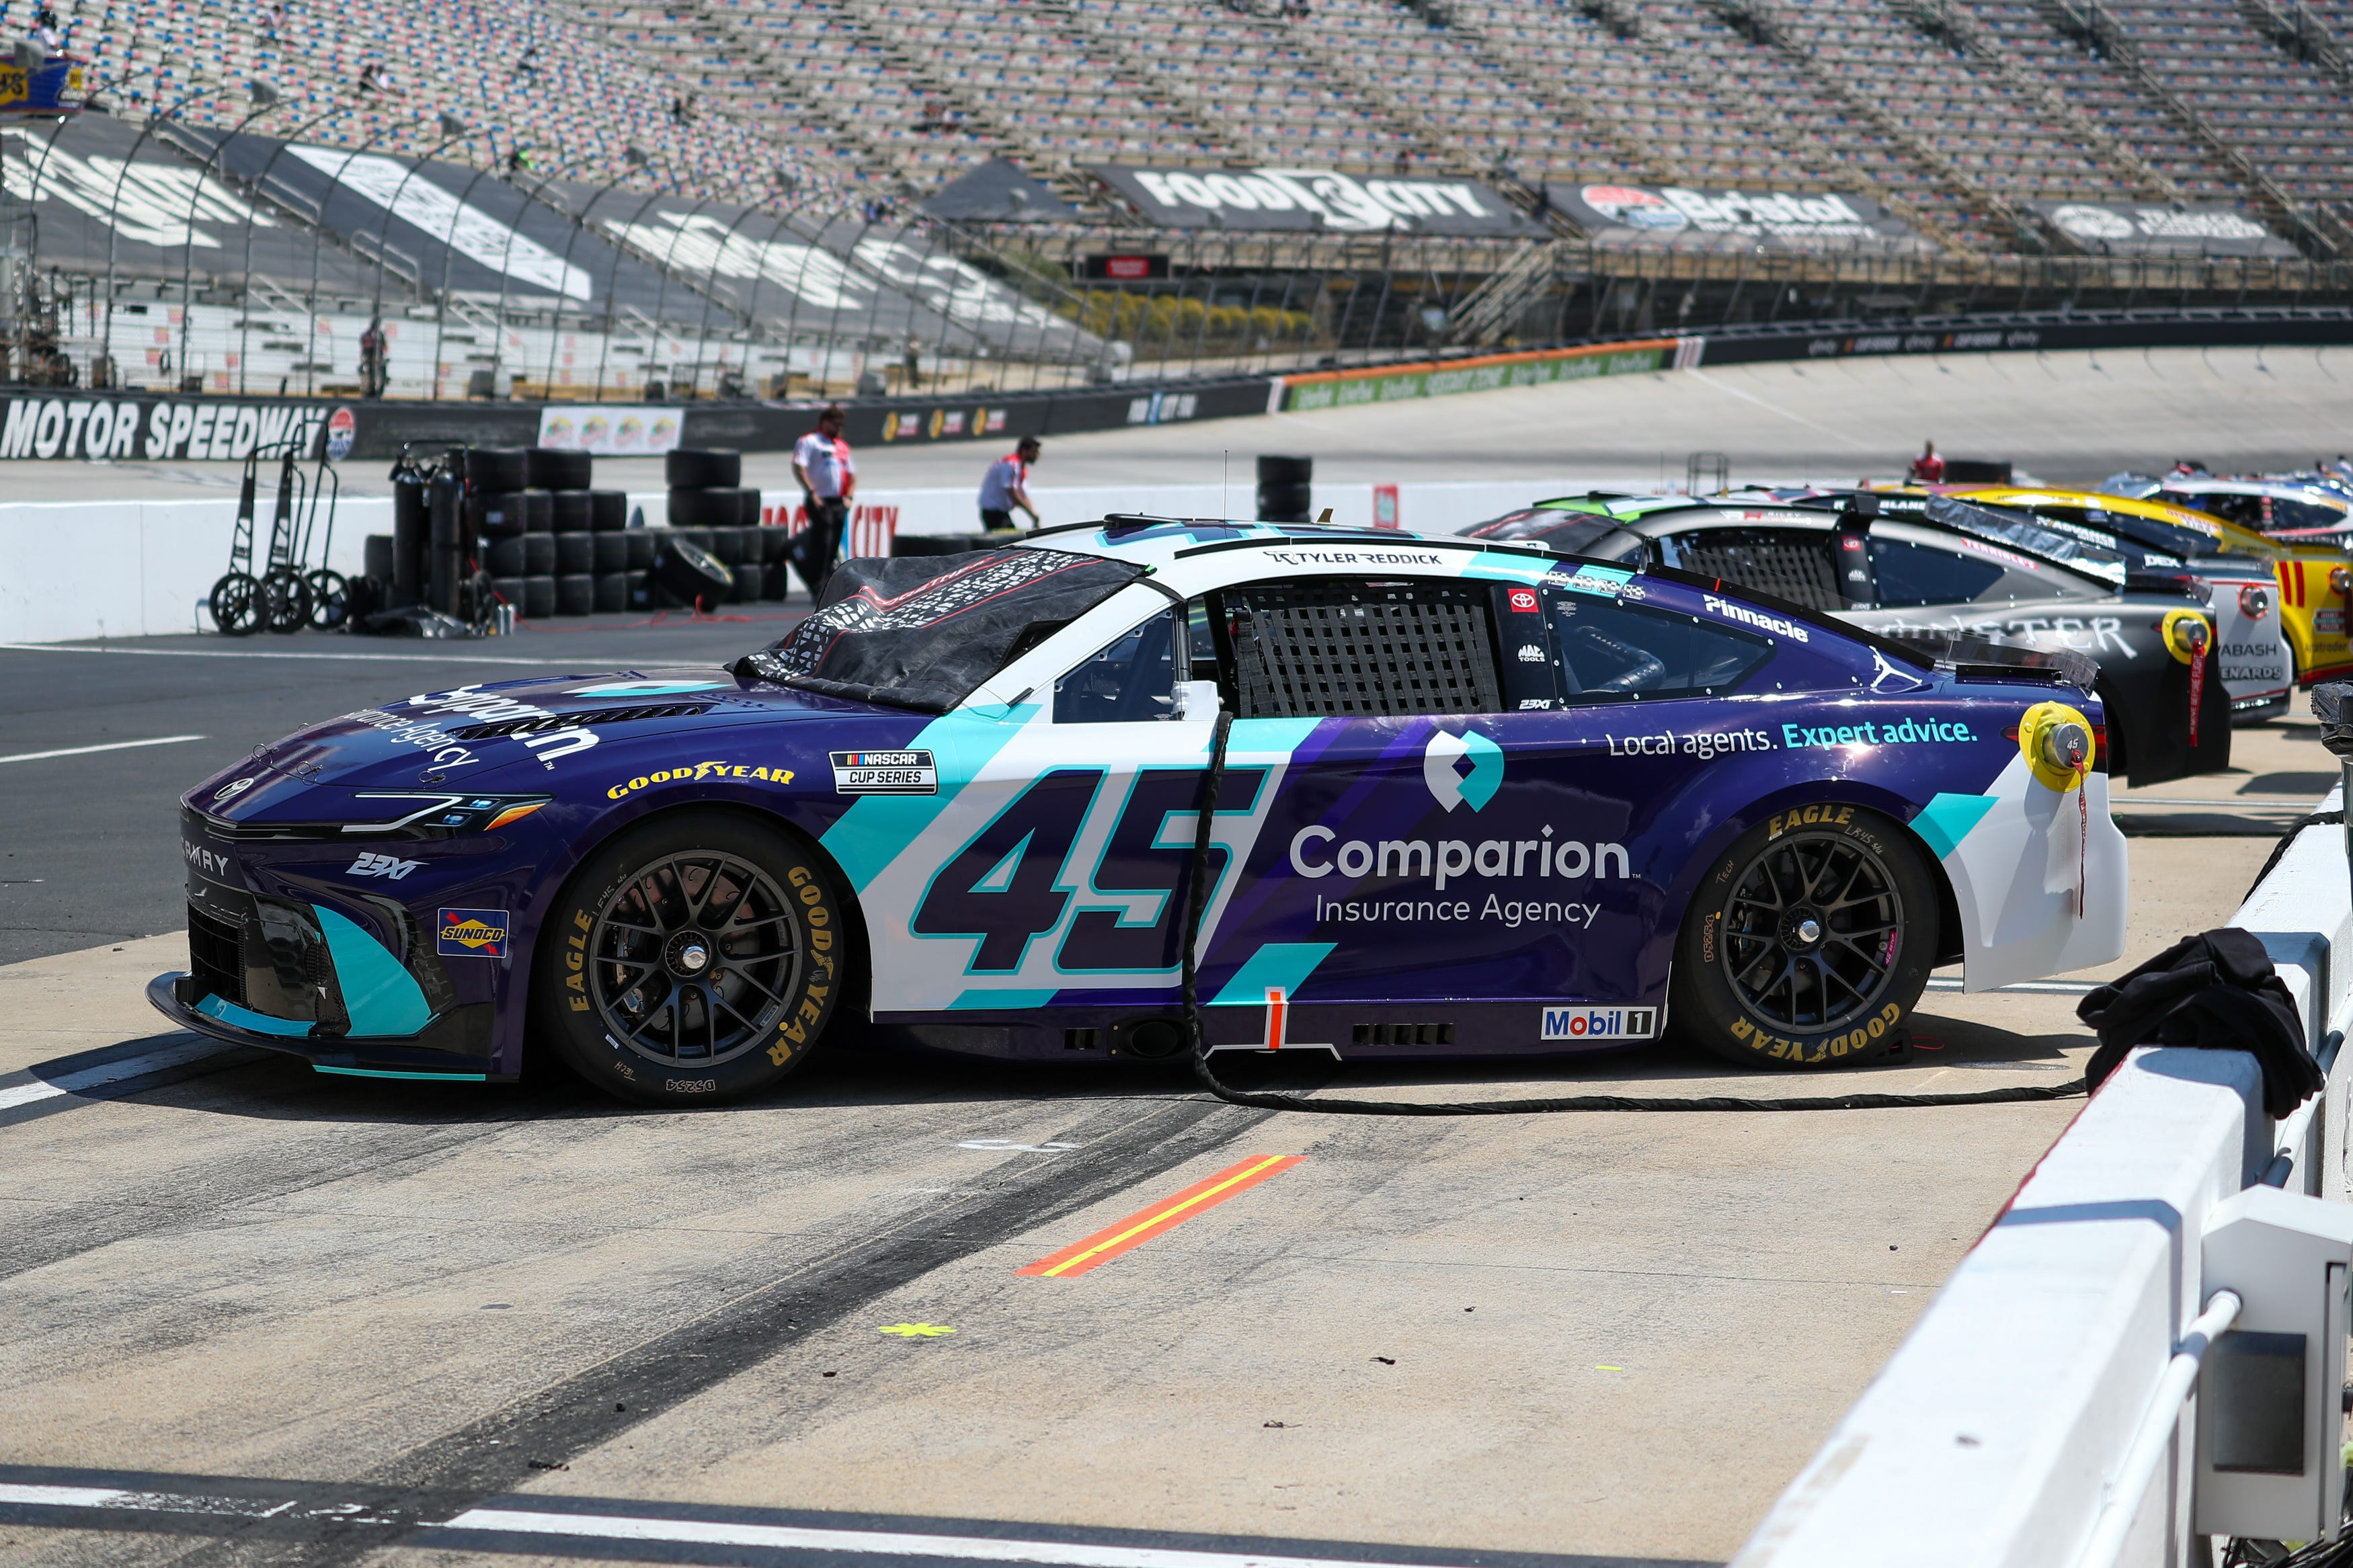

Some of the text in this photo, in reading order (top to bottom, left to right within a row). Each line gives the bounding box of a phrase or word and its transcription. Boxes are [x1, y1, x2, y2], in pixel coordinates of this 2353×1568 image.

[1133, 169, 1491, 218] FOOD CITY
[1662, 186, 1862, 223] Bristol
[0, 398, 140, 460] MOTOR
[145, 402, 328, 460] SPEEDWAY
[1879, 499, 1927, 511] BLANE
[850, 505, 899, 559] CITY
[1296, 552, 1359, 563] TYLER
[1359, 553, 1443, 565] REDDICK
[1702, 593, 1809, 644] Pinnacle
[1864, 615, 2139, 661] NSTER
[1518, 644, 1545, 657] MAC
[2220, 665, 2282, 681] ENARDS
[343, 708, 480, 772] urance Agency
[1607, 718, 1979, 760] Local agents. Expert advice.
[2066, 737, 2079, 750] 45
[848, 769, 922, 784] CUP SERIES
[863, 753, 918, 766] NASCAR
[606, 761, 795, 800] GOODYEAR
[1769, 804, 1856, 839] EAGLE
[908, 764, 1275, 976] 45
[1289, 824, 1630, 891] Comparion
[1316, 893, 1602, 930] Insurance Agency
[443, 926, 506, 943] SUNOCO
[1703, 914, 1716, 964] D5254
[565, 908, 594, 1013] EAGLE
[765, 865, 835, 1067] GOODYEAR
[1544, 1010, 1621, 1037] Mobil
[1730, 1002, 1901, 1064] GOODYEAR
[666, 1078, 717, 1094] D5254
